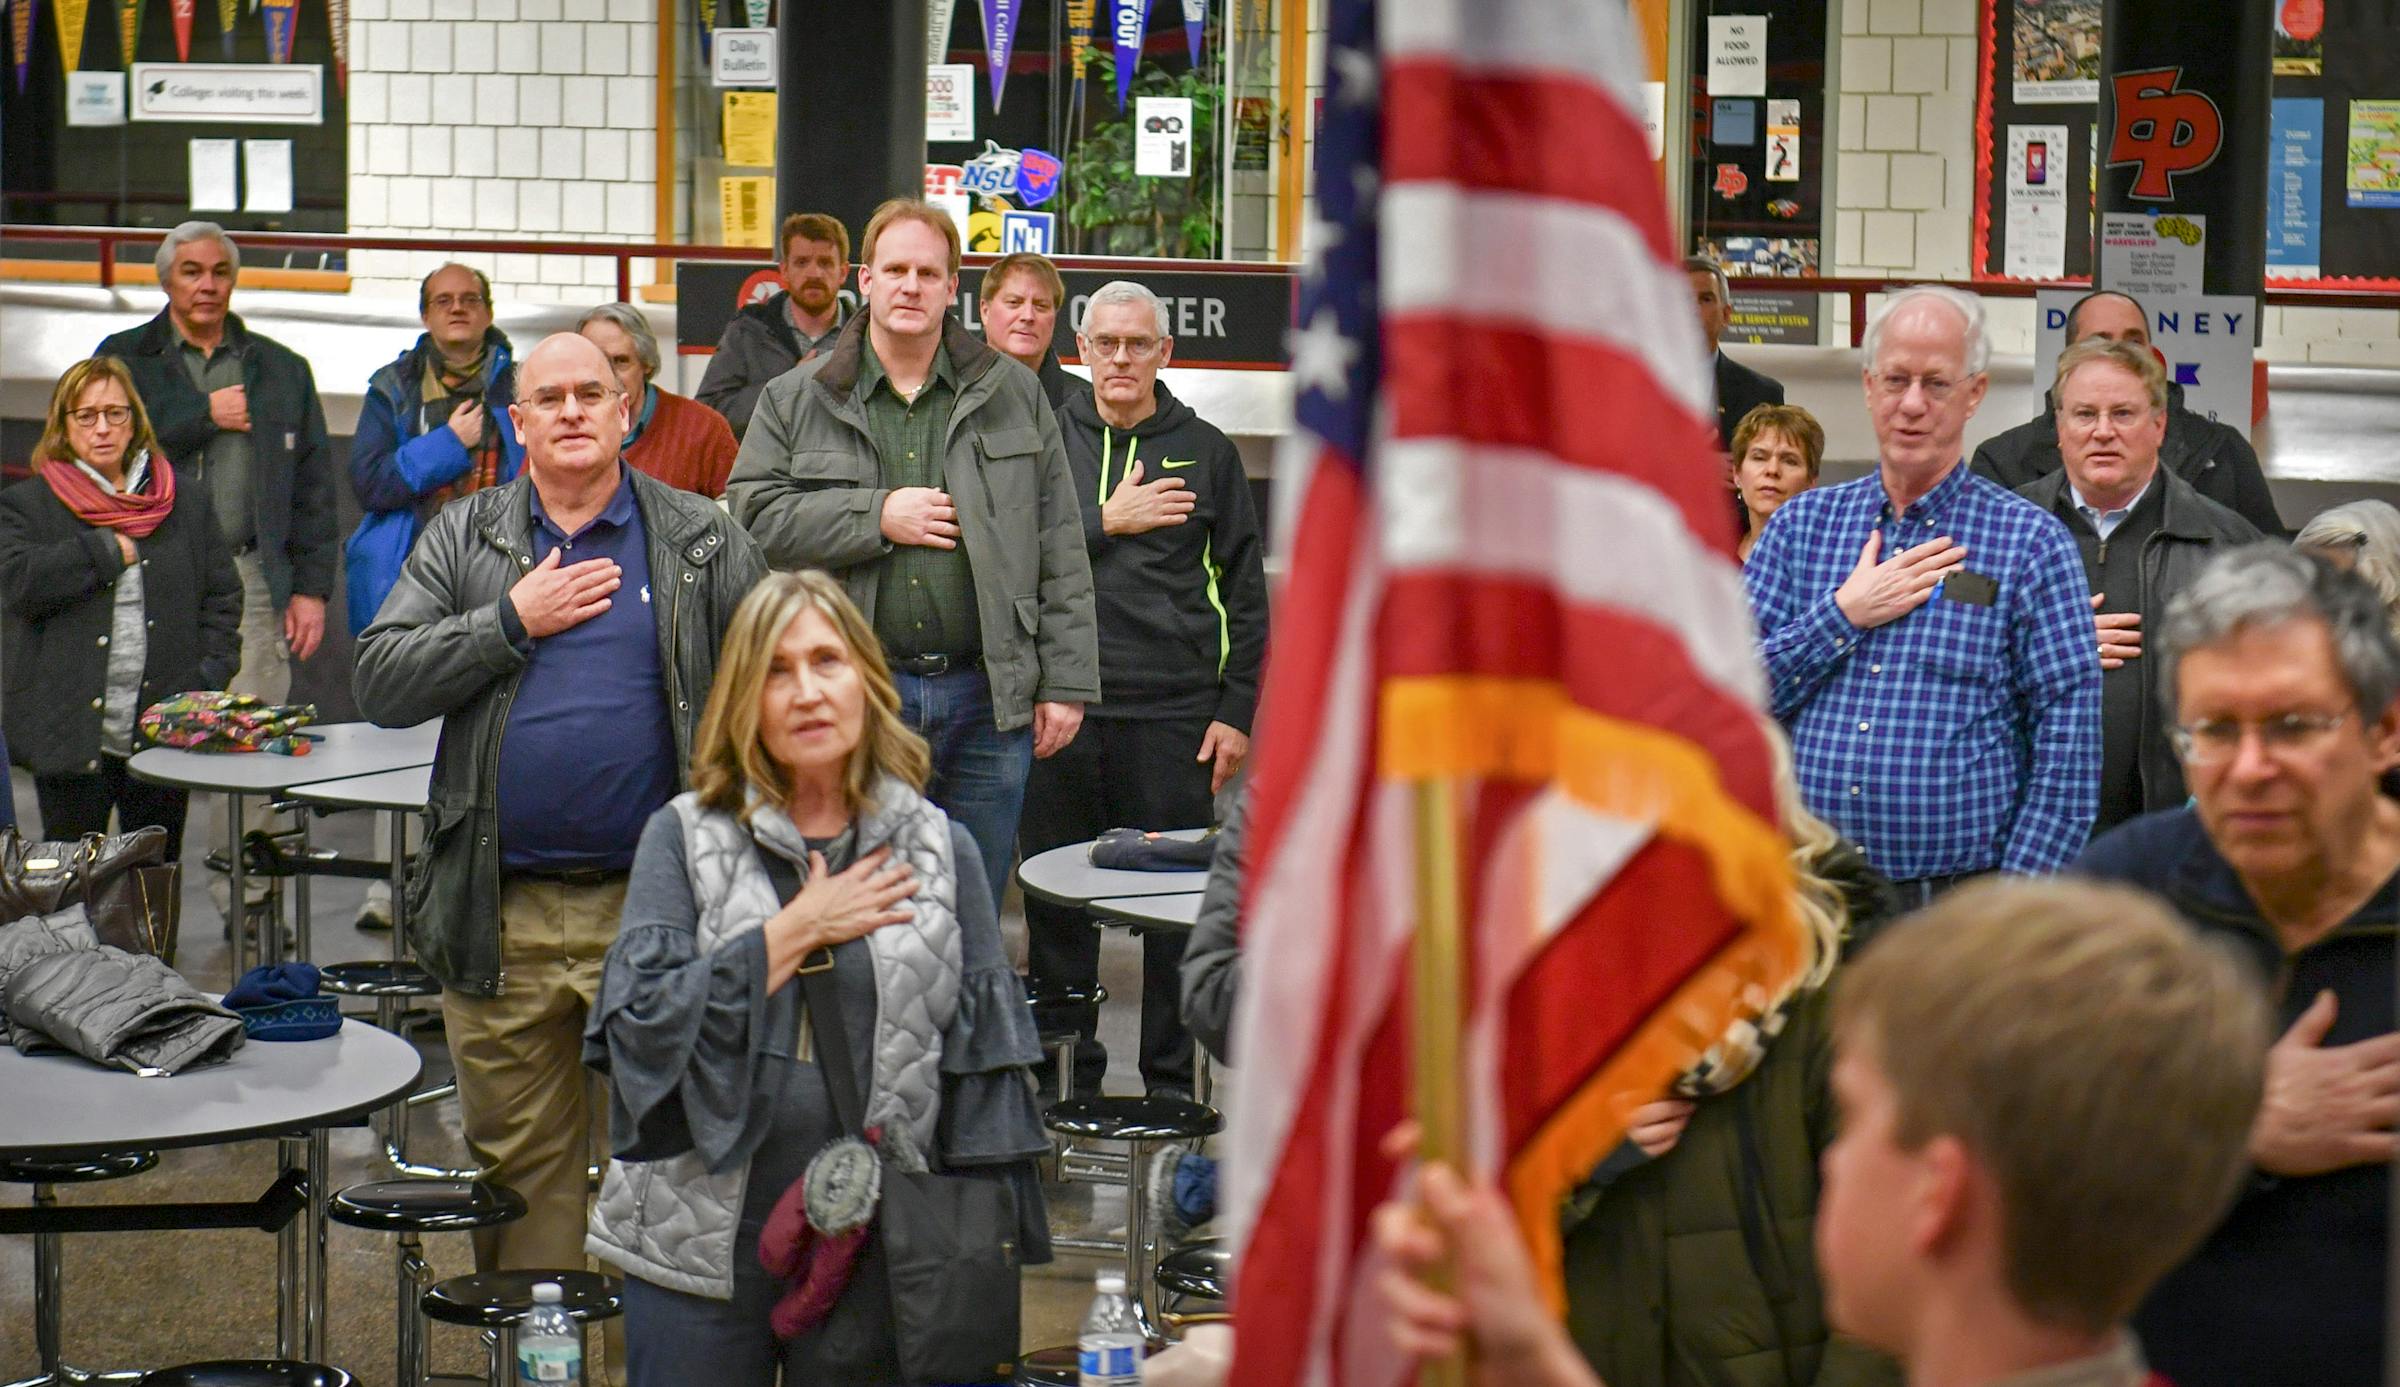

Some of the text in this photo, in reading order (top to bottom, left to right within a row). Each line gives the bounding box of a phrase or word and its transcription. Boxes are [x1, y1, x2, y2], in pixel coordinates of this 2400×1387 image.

[1729, 26, 1744, 35] NO
[991, 12, 1009, 67] College
[1723, 41, 1750, 51] FOOD
[729, 39, 760, 54] Daily
[722, 58, 767, 71] Bulletin
[1715, 56, 1759, 66] ALLOWED
[2046, 308, 2243, 336] DNEY
